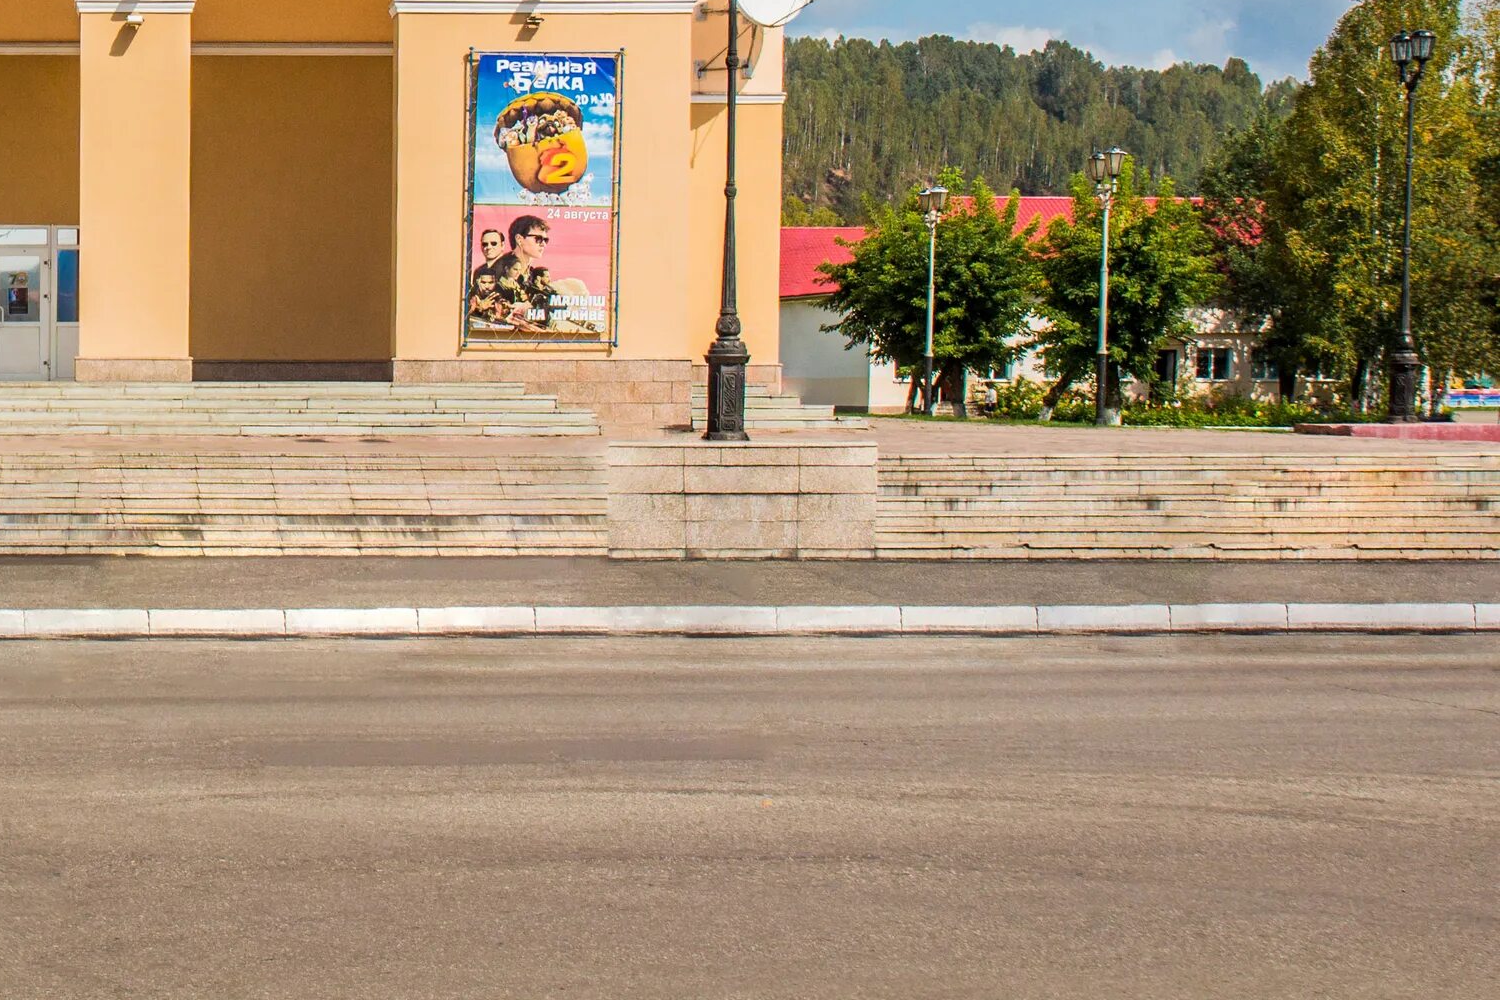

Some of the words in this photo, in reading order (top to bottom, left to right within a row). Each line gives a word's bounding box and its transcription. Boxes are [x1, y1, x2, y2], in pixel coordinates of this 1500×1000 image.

[575, 94, 589, 105] 2D
[599, 92, 614, 106] 3D
[546, 152, 577, 184] 2
[547, 208, 561, 219] 24
[563, 211, 609, 222] августа
[549, 294, 606, 307] МАЛЫШ
[527, 308, 546, 321] НА
[550, 307, 605, 321] ДРАЙВЕ
